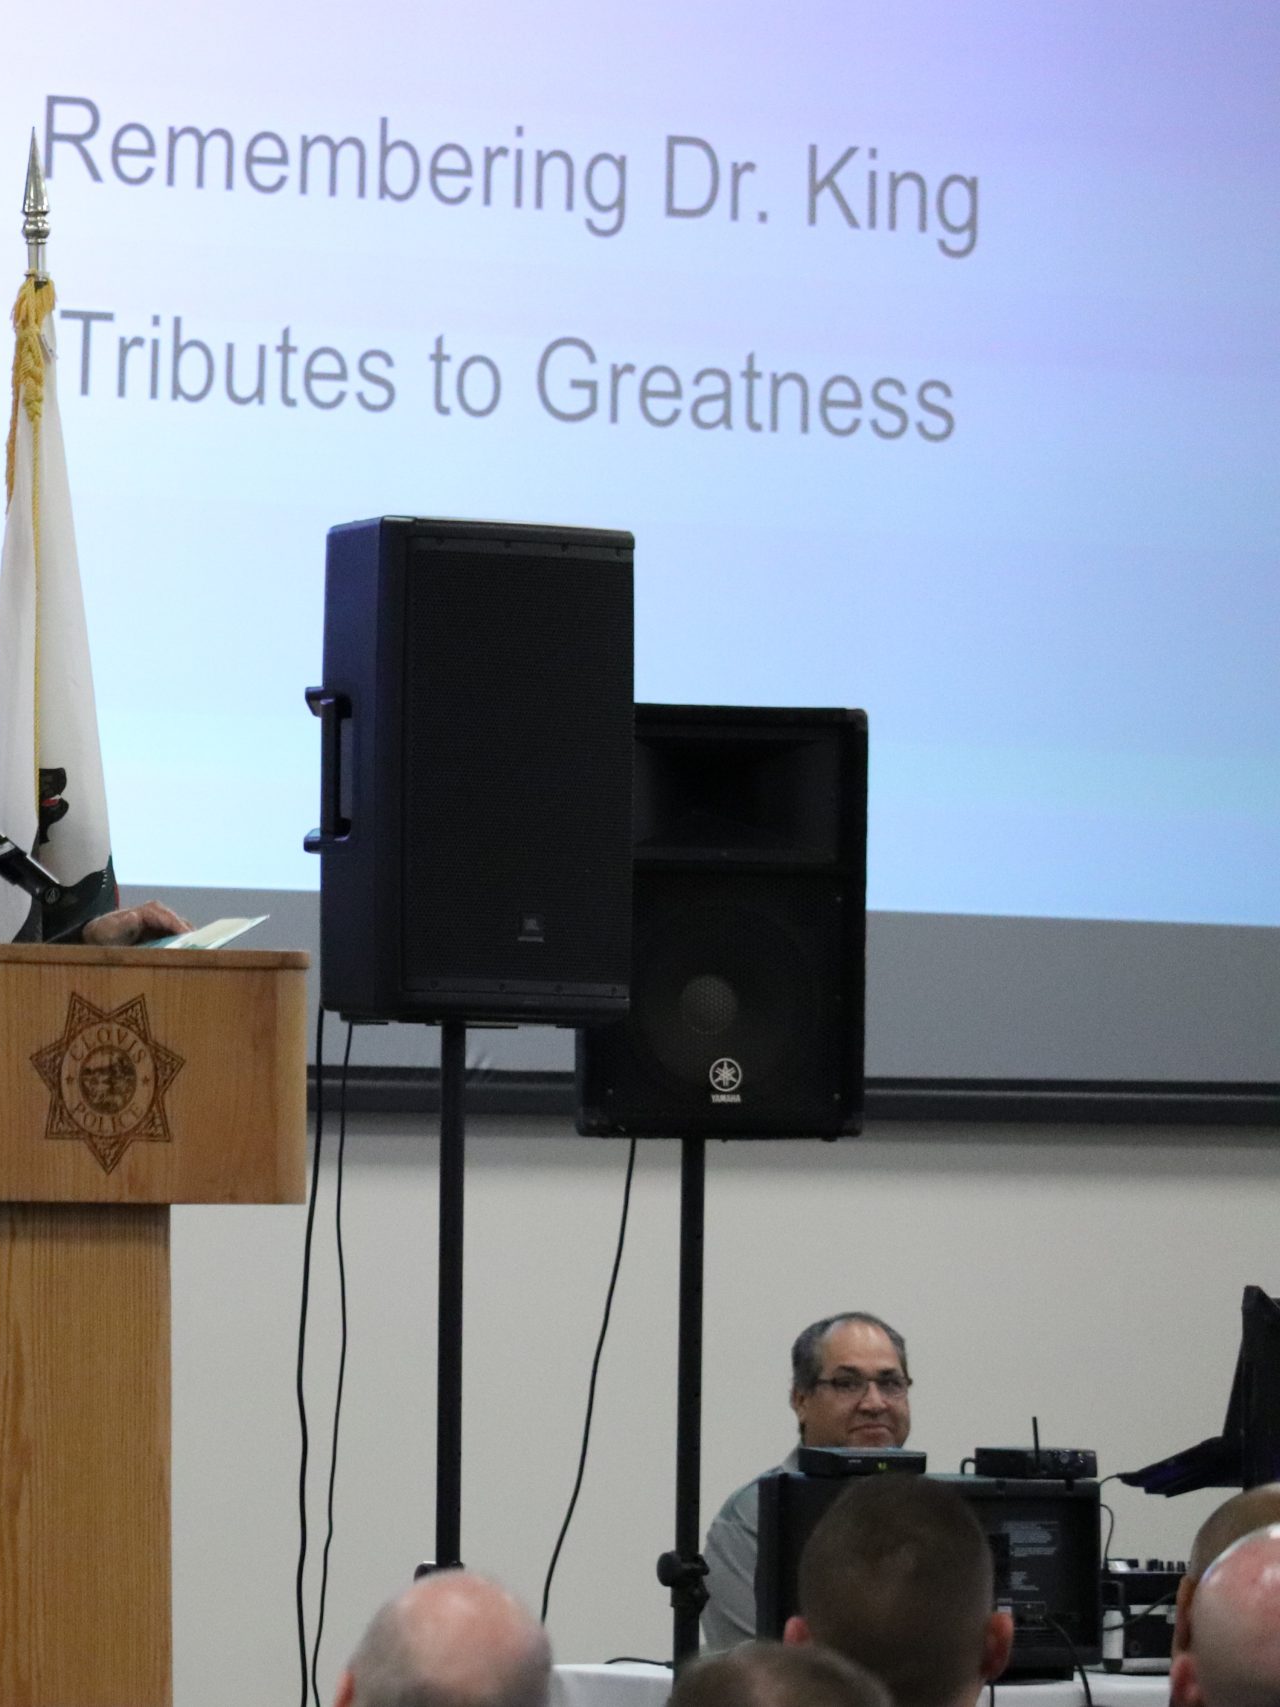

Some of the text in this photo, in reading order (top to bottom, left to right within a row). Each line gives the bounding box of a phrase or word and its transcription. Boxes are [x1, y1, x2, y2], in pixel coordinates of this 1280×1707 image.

[43, 94, 979, 259] Remembering Dr. King
[59, 309, 956, 443] Tributes to Greatness
[70, 1027, 146, 1064] CLOVIS
[73, 1102, 143, 1133] POLICE
